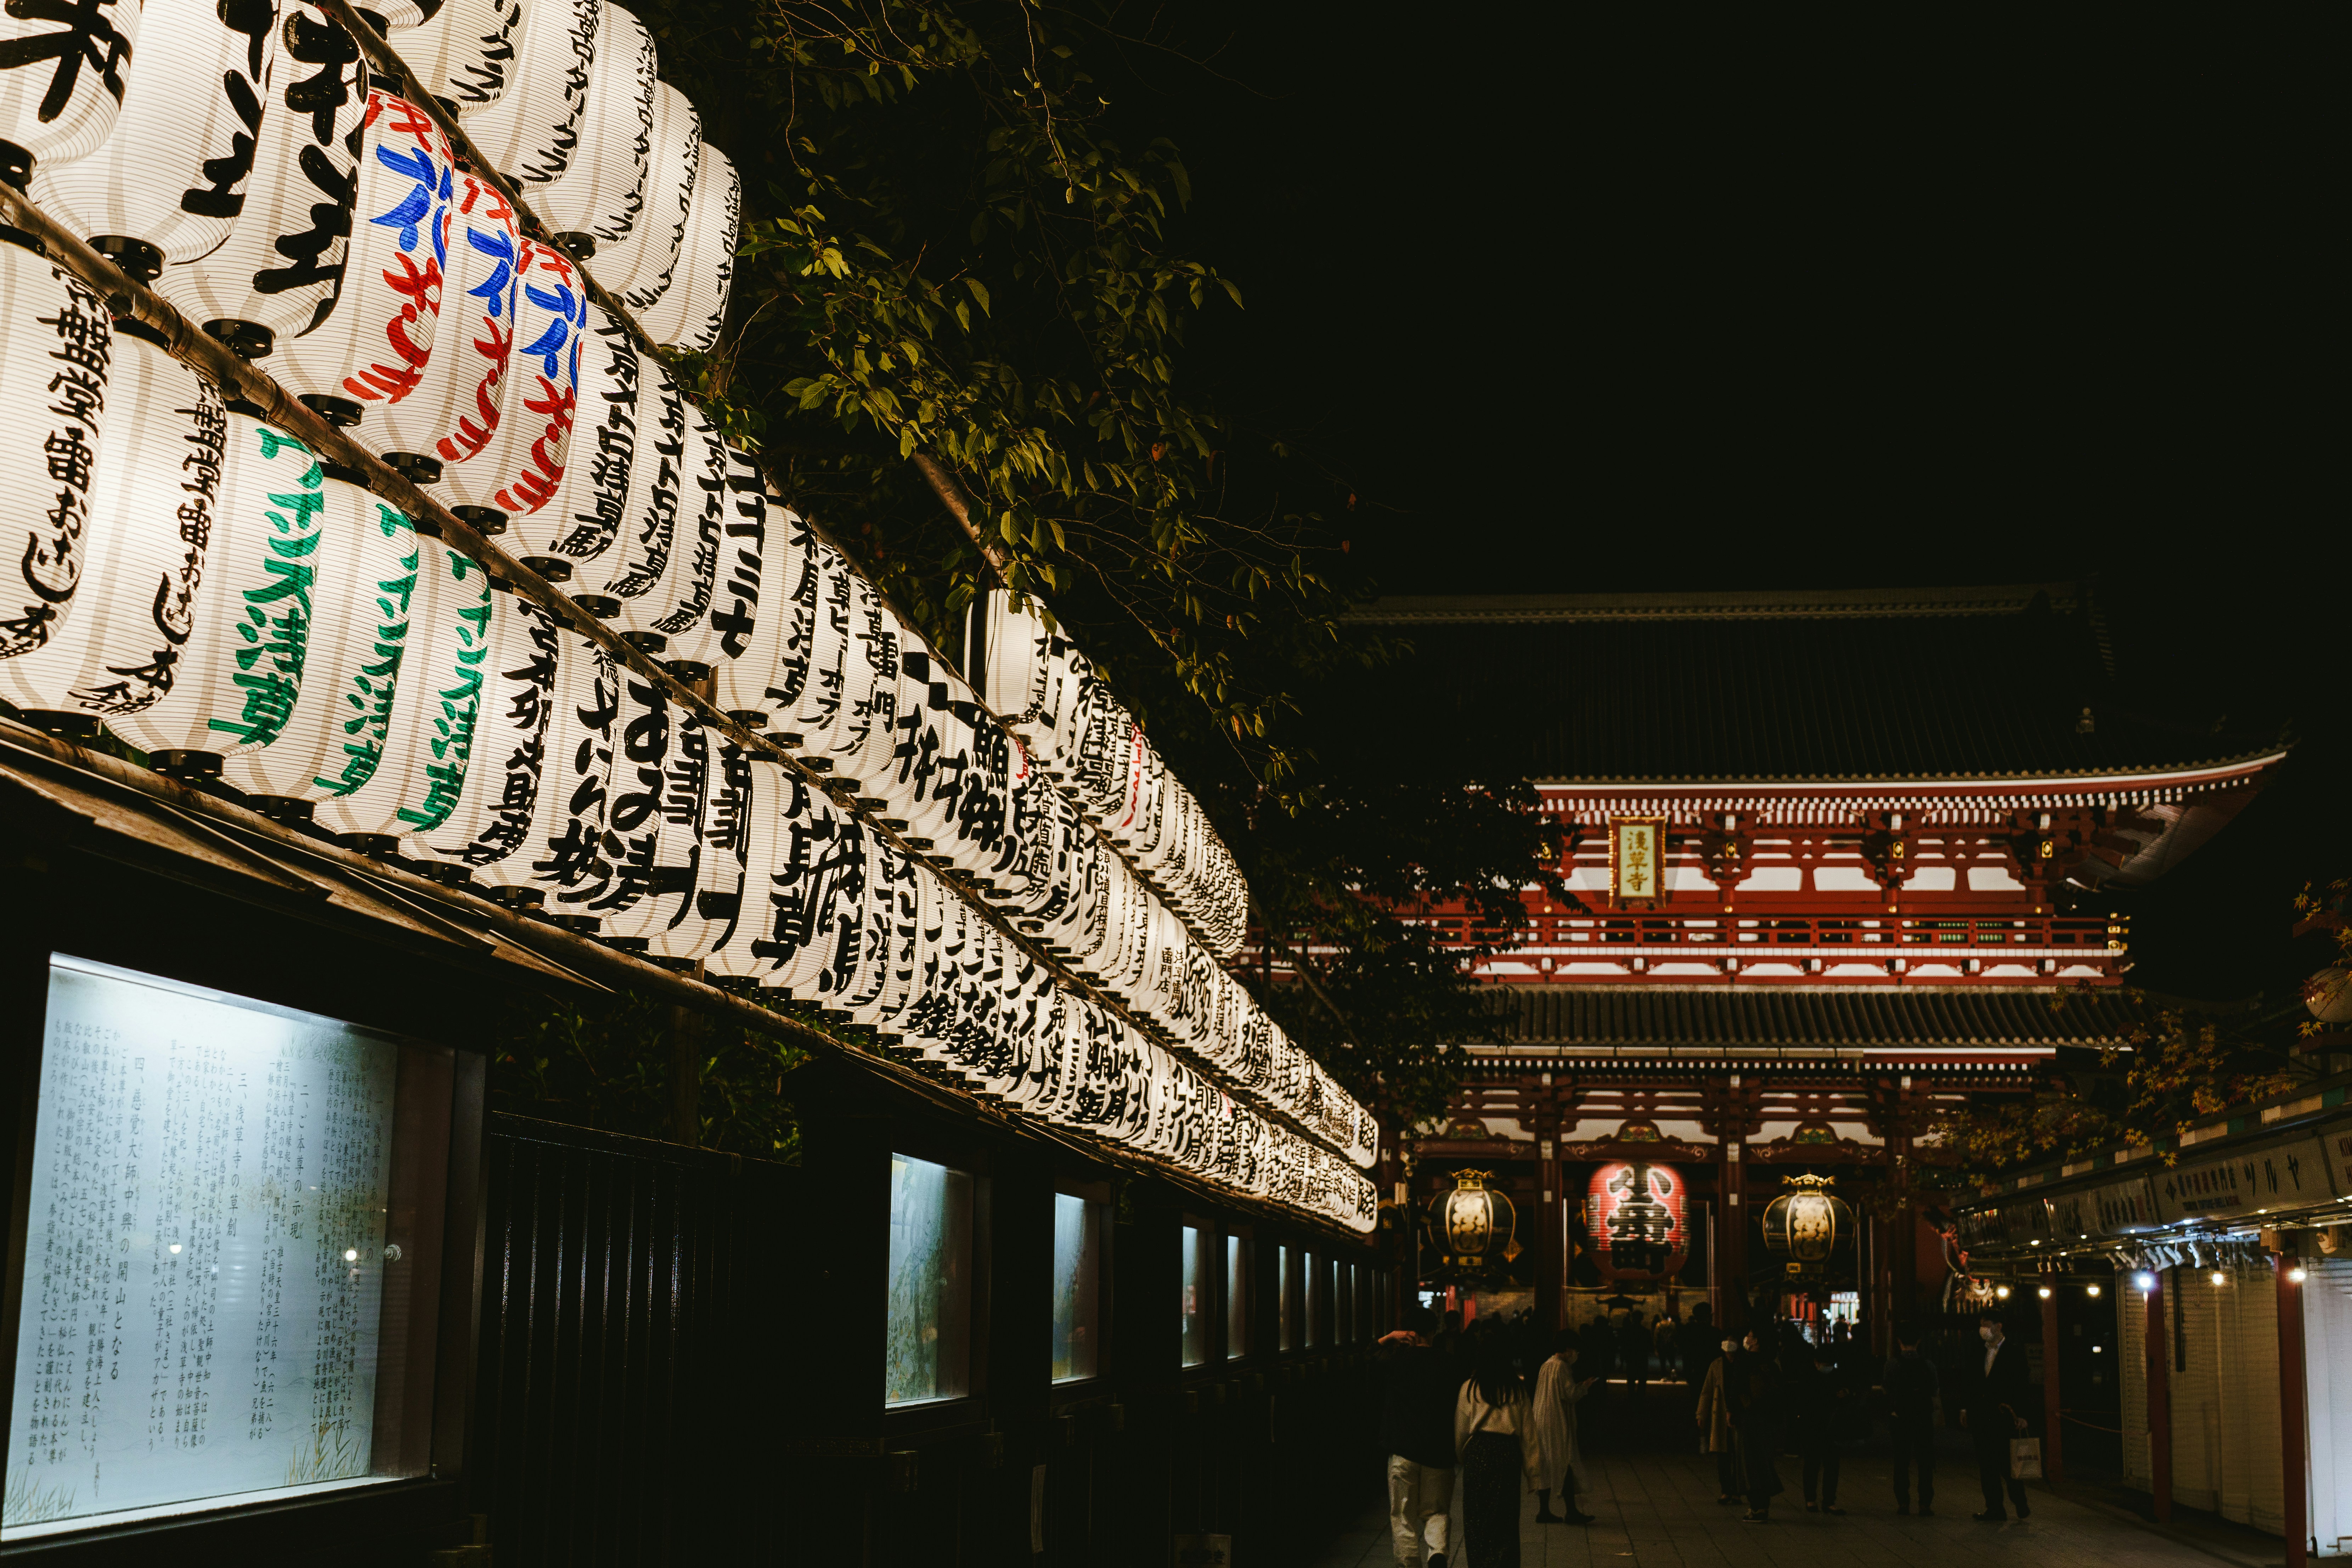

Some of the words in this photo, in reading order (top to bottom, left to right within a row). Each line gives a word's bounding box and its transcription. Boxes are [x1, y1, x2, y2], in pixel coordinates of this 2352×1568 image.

[874, 631, 899, 734] 雷門
[1627, 830, 1648, 892] 浅草寺
[1153, 947, 1172, 993] 雷門店
[192, 1045, 203, 1095] である。
[226, 1072, 248, 1237] 三、浅草寺の草創
[290, 1083, 310, 1239] 二、ご本尊の示現
[156, 1059, 194, 1443] この三人を祀ったのが「浅神社（三社さま）」である。
